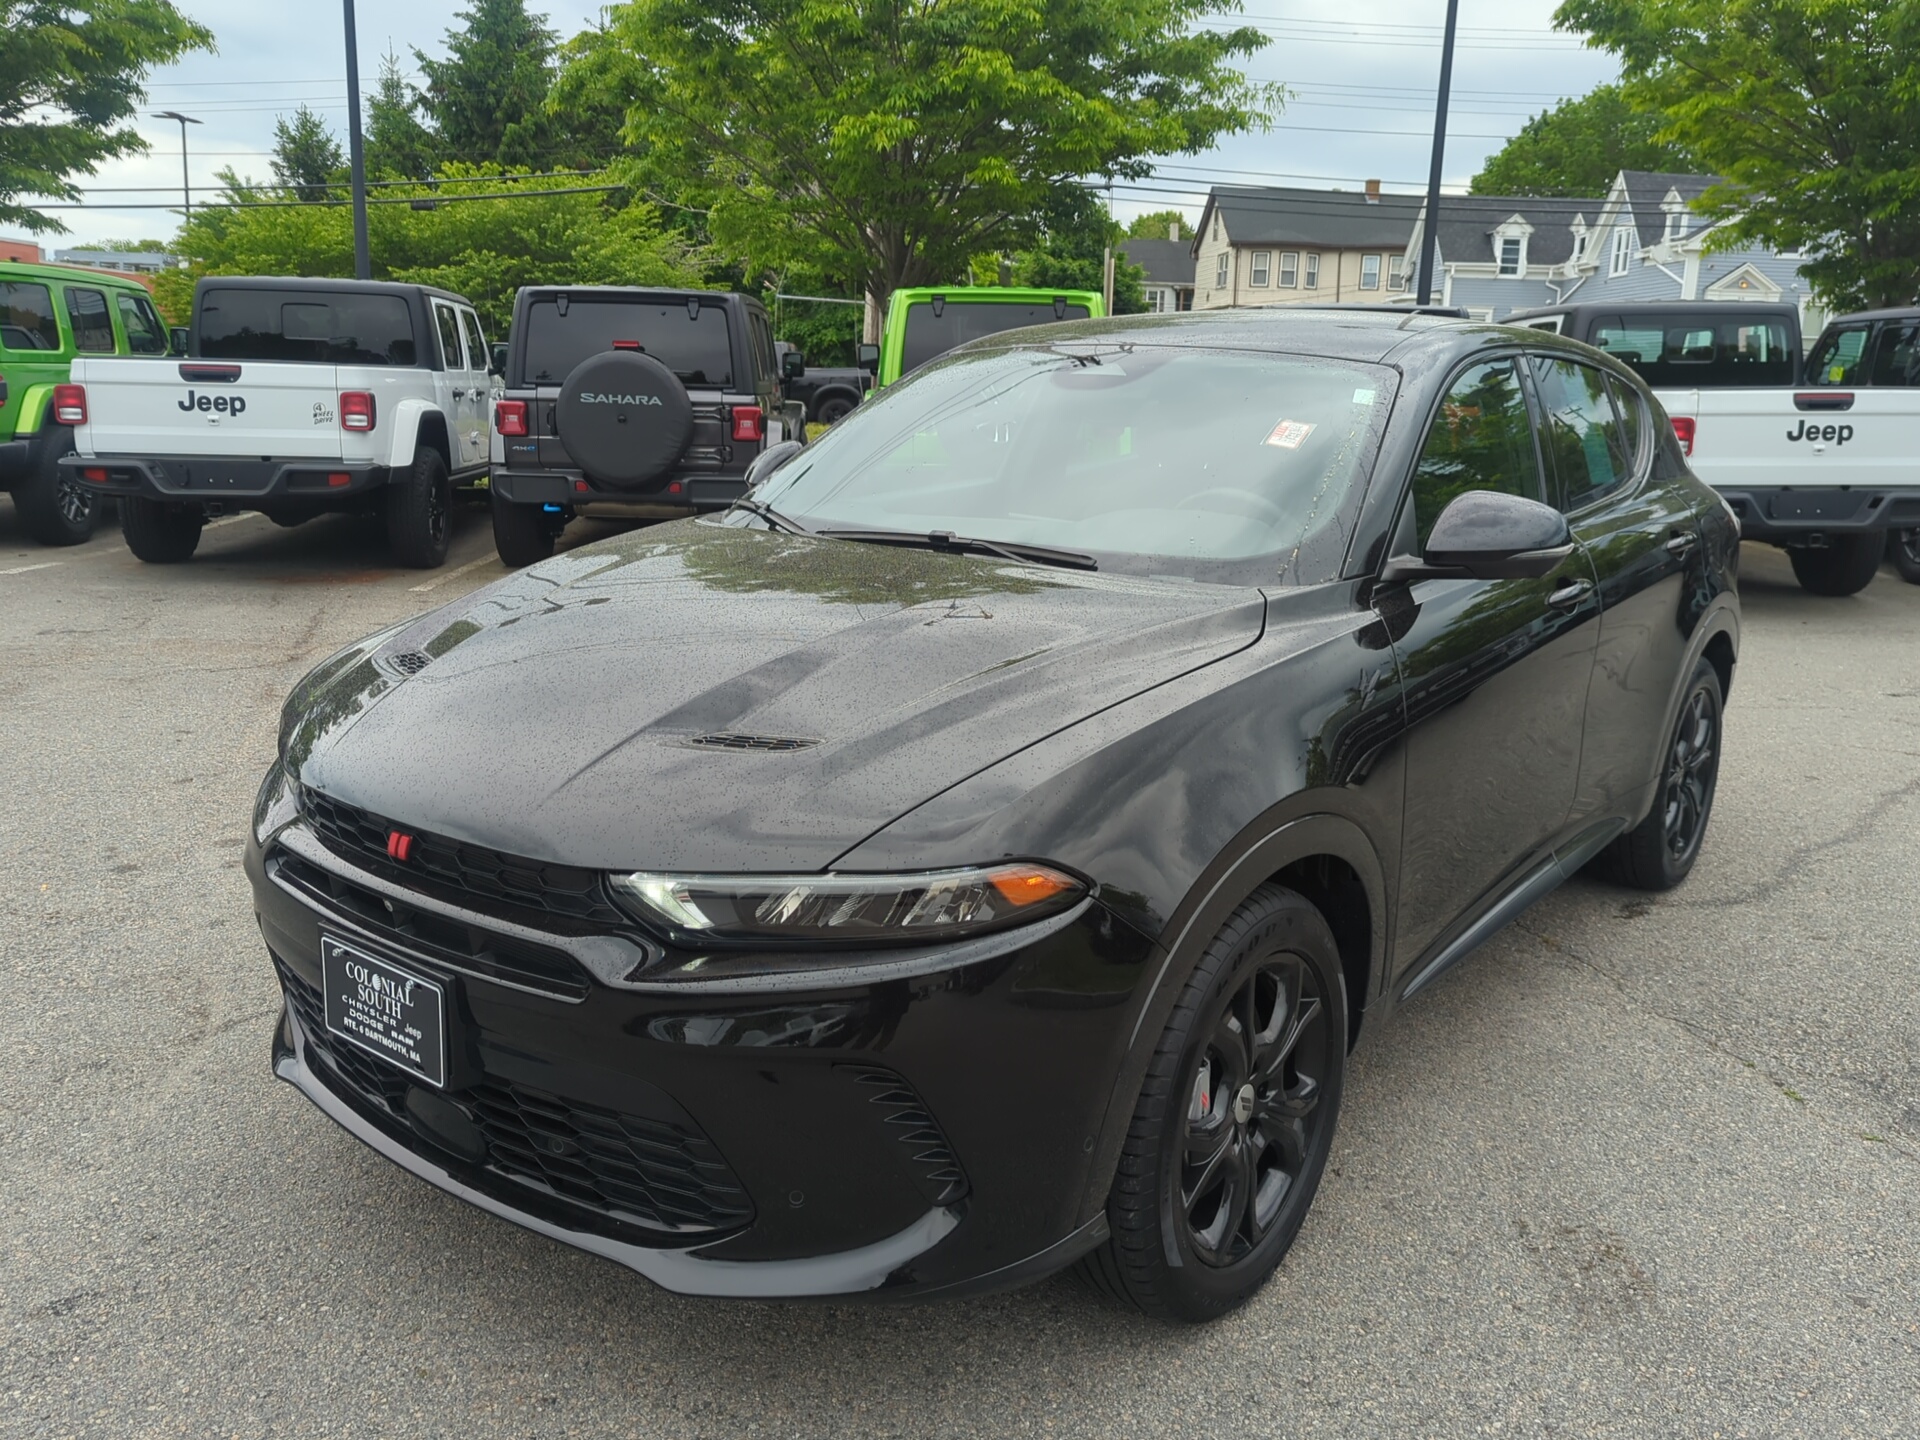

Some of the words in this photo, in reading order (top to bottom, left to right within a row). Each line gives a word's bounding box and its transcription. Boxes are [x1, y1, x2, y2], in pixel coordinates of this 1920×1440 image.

[178, 390, 246, 417] Jeep
[313, 410, 333, 418] WHEEL
[580, 393, 662, 406] SAHARA
[314, 416, 333, 425] DRIVE
[1786, 419, 1853, 446] Jeep
[346, 961, 414, 1007] COLONIAL
[358, 984, 402, 1019] SOUTH
[342, 994, 397, 1027] CHRYSLER
[404, 1023, 422, 1041] Jeep
[349, 1008, 384, 1032] DODGE
[391, 1030, 414, 1047] RAM
[343, 1016, 358, 1031] RTE.
[359, 1025, 364, 1034] 6
[364, 1027, 409, 1058] DARTMOUTH,
[410, 1050, 421, 1063] MA
